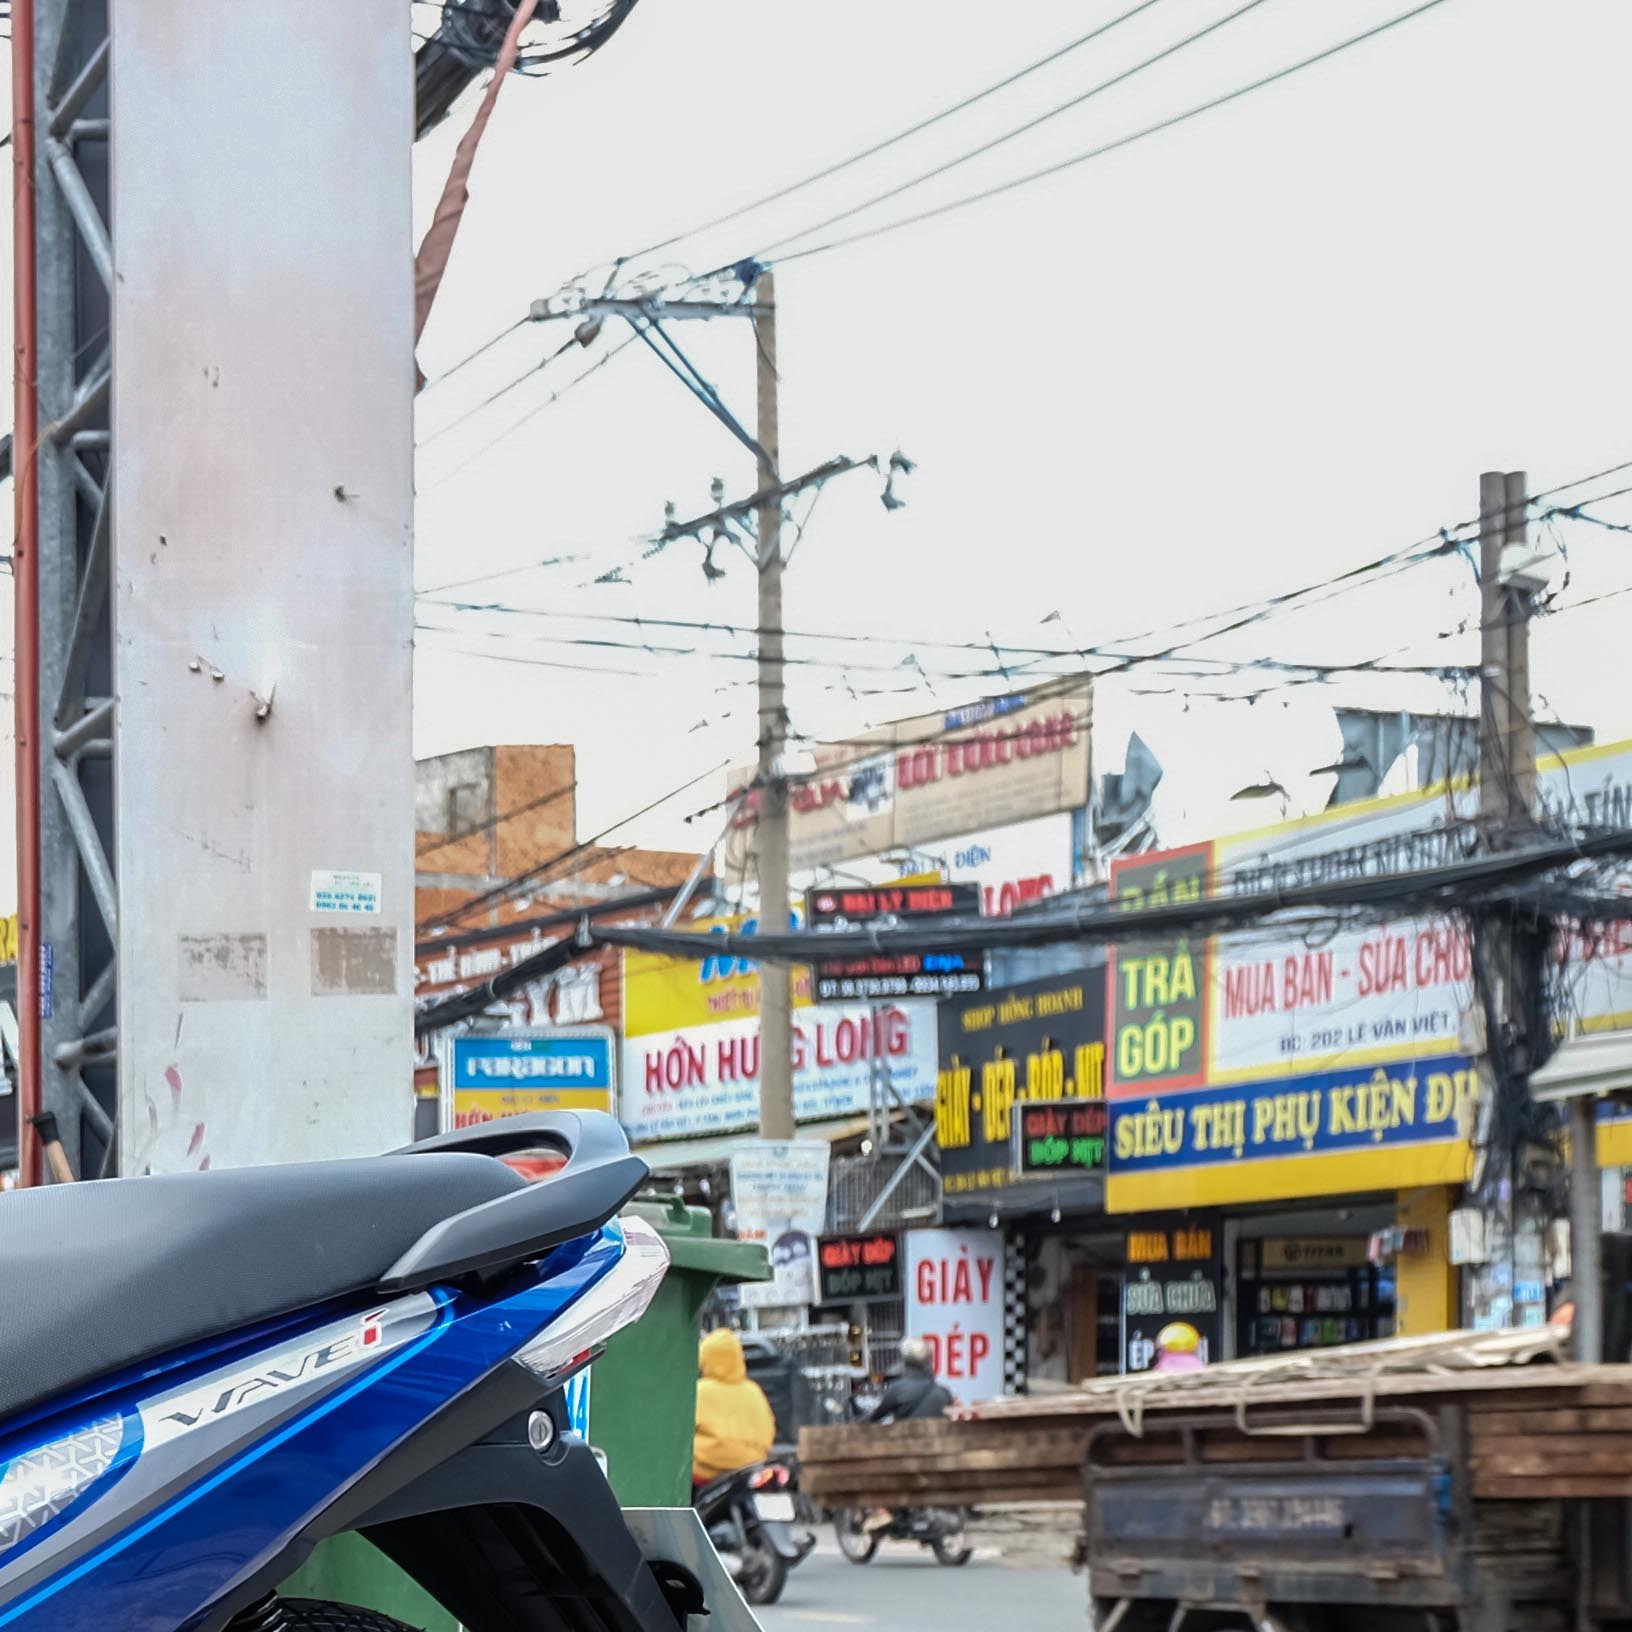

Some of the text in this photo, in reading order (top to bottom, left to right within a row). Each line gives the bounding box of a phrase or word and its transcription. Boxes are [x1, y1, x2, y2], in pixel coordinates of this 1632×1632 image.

[1225, 961, 1277, 1019] MUA
[1119, 1011, 1194, 1079] GÓP
[1115, 1096, 1185, 1161] SIÊU
[1192, 1101, 1246, 1160] THỊ
[1253, 1086, 1322, 1152] PHỤ
[1327, 1067, 1418, 1144] KIỆN
